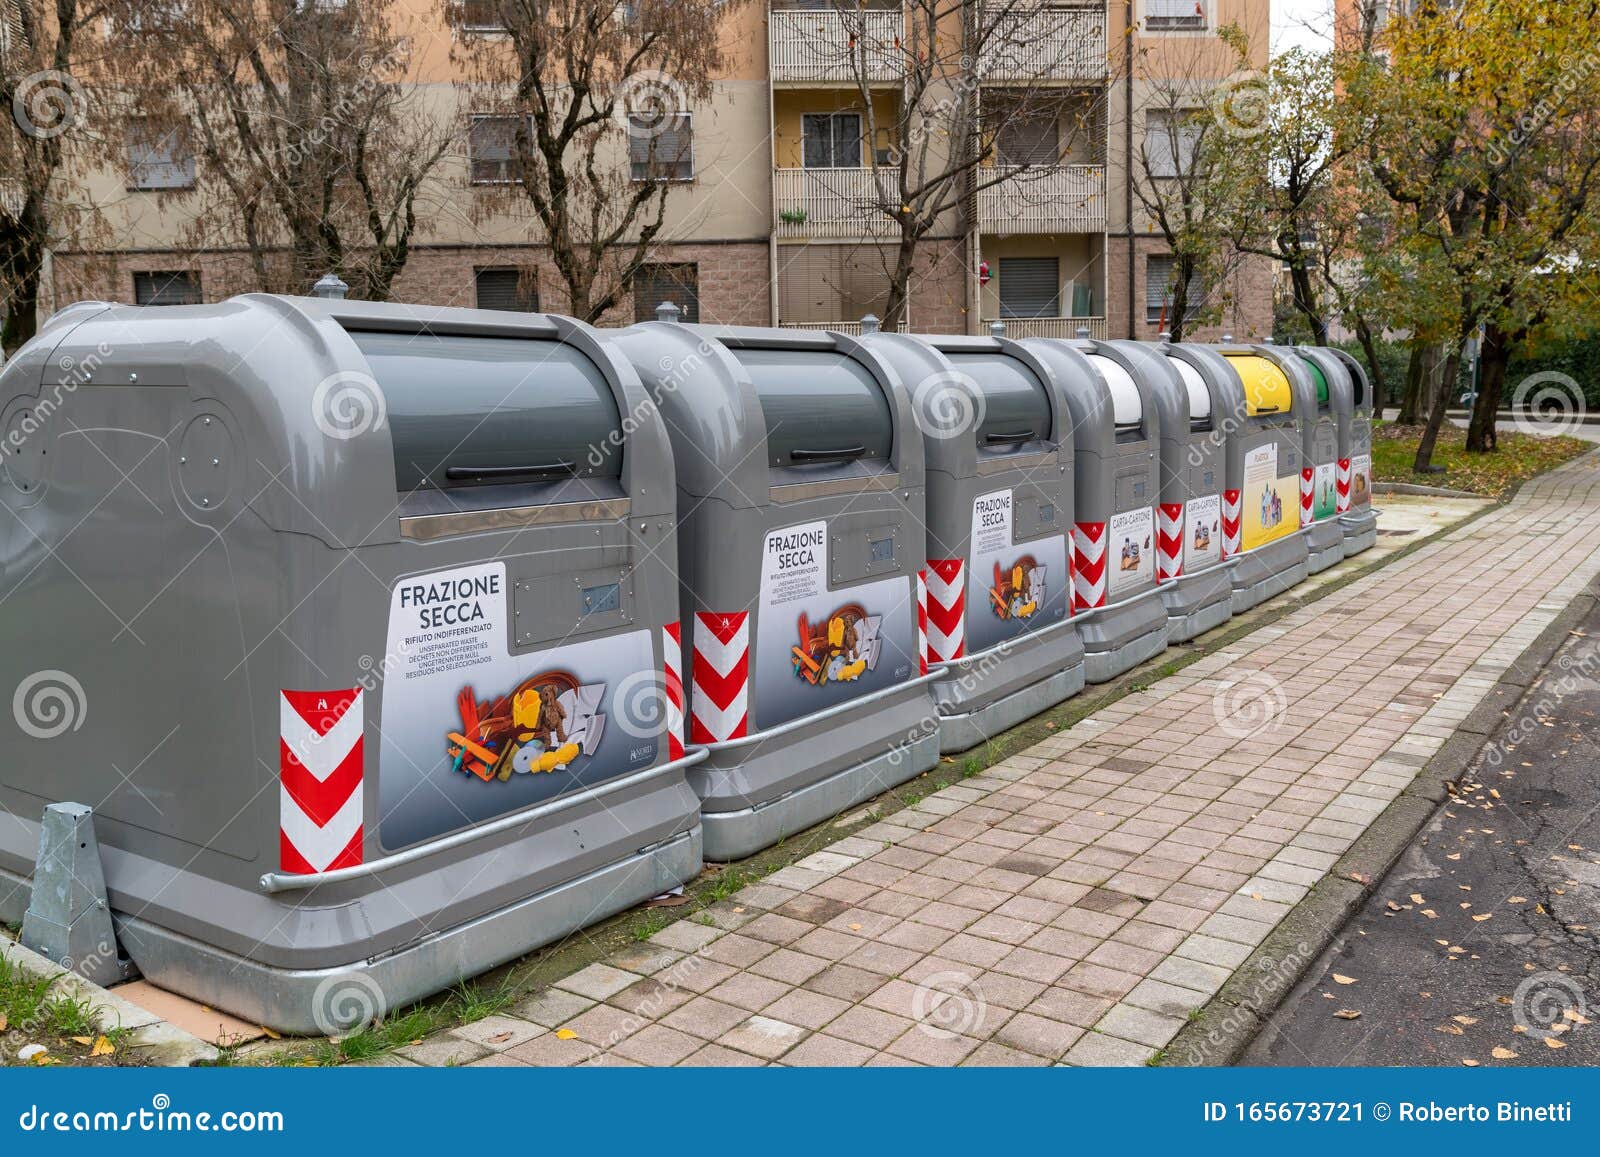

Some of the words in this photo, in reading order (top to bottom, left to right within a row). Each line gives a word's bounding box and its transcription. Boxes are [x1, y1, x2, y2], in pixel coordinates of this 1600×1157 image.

[976, 496, 1010, 513] FRAZIONE
[982, 512, 1004, 527] SECCA
[1113, 510, 1150, 529] CARTA-CARTONE
[769, 530, 823, 553] FRAZIONE
[779, 550, 814, 569] SECCA
[400, 574, 500, 608] FRAZIONE
[420, 601, 484, 629] SECCA
[405, 633, 433, 645] RIFIUTO
[434, 623, 492, 639] INDIFFERENZIATO
[420, 640, 460, 653] UNSEPARATED
[461, 636, 479, 646] WASTE
[436, 649, 450, 657] NON
[405, 667, 435, 679] RESIDUOS
[436, 665, 446, 673] NO
[446, 656, 492, 670] SELECCIONADOS
[418, 655, 463, 668] UNGETRENNTER
